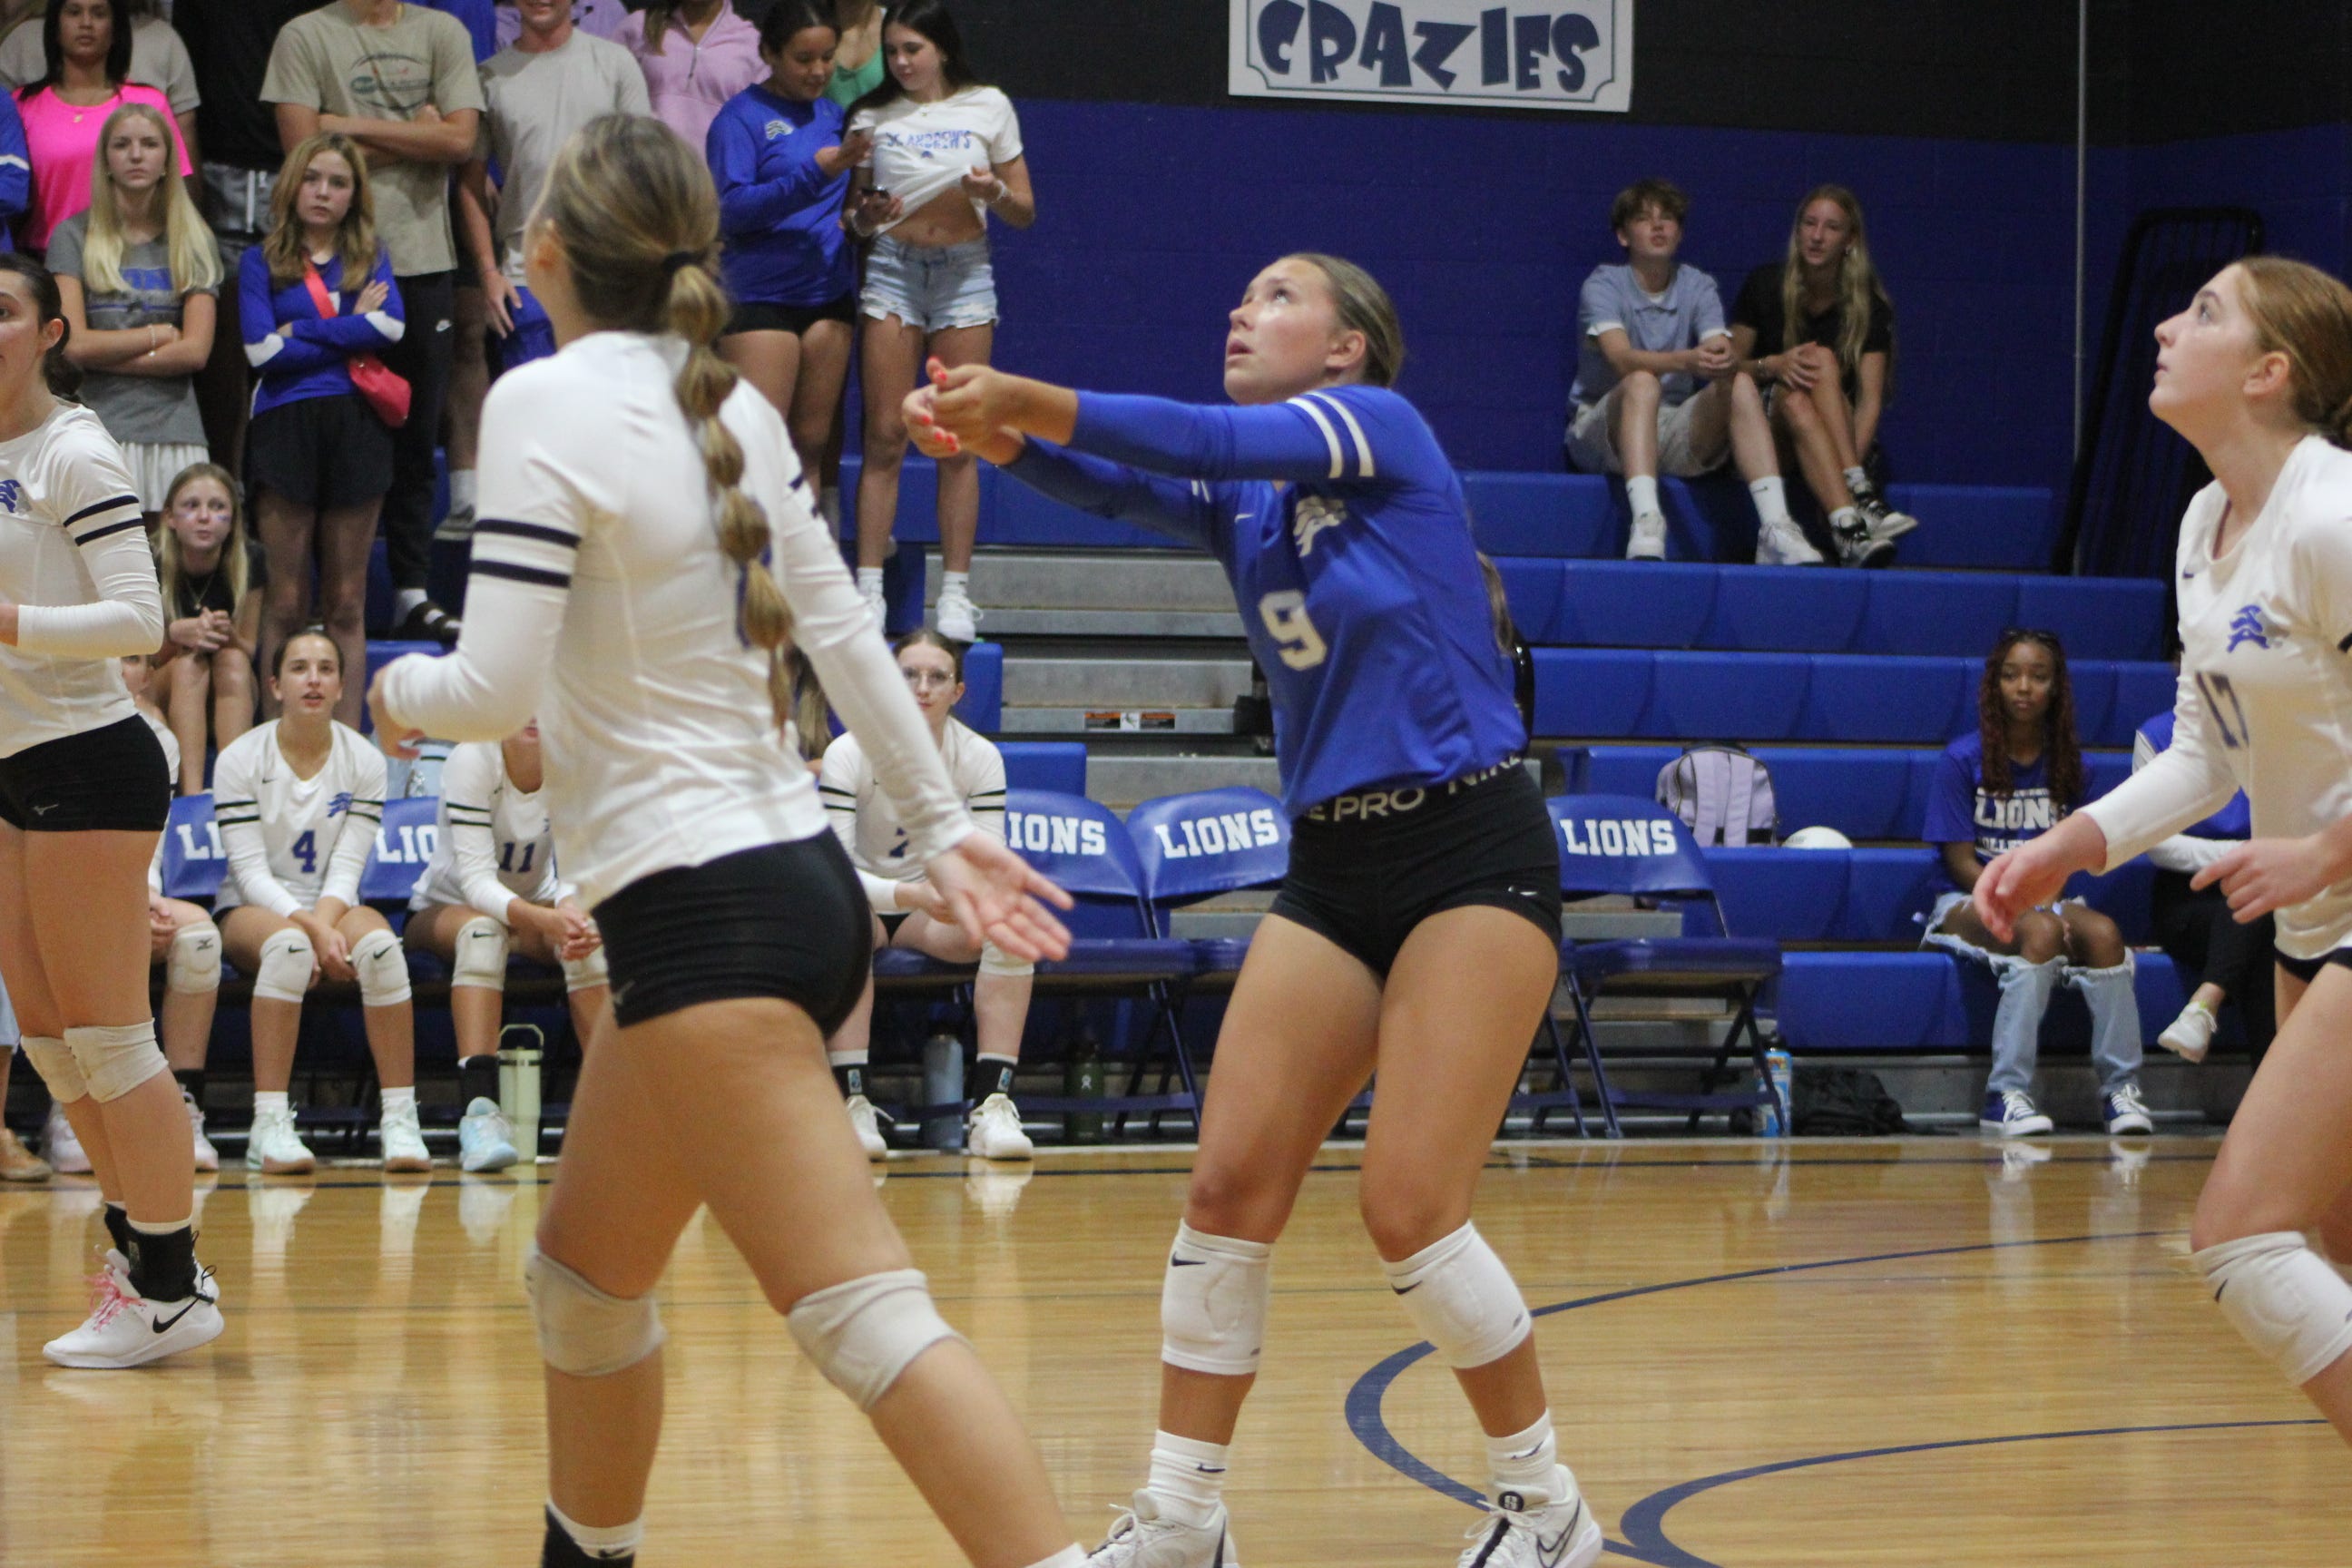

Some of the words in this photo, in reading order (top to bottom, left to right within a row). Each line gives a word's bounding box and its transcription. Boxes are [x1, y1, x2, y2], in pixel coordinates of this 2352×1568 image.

[1258, 0, 1601, 93] CRAZIES
[1258, 589, 1328, 671] 9
[2195, 671, 2249, 750] 17
[1334, 788, 1426, 821] PRO
[291, 829, 317, 873] 4
[376, 824, 439, 863] LIO
[1007, 812, 1106, 856] IONS
[1154, 808, 1279, 858] LIONS
[1559, 819, 1677, 857] LIONS
[500, 841, 536, 874] 11
